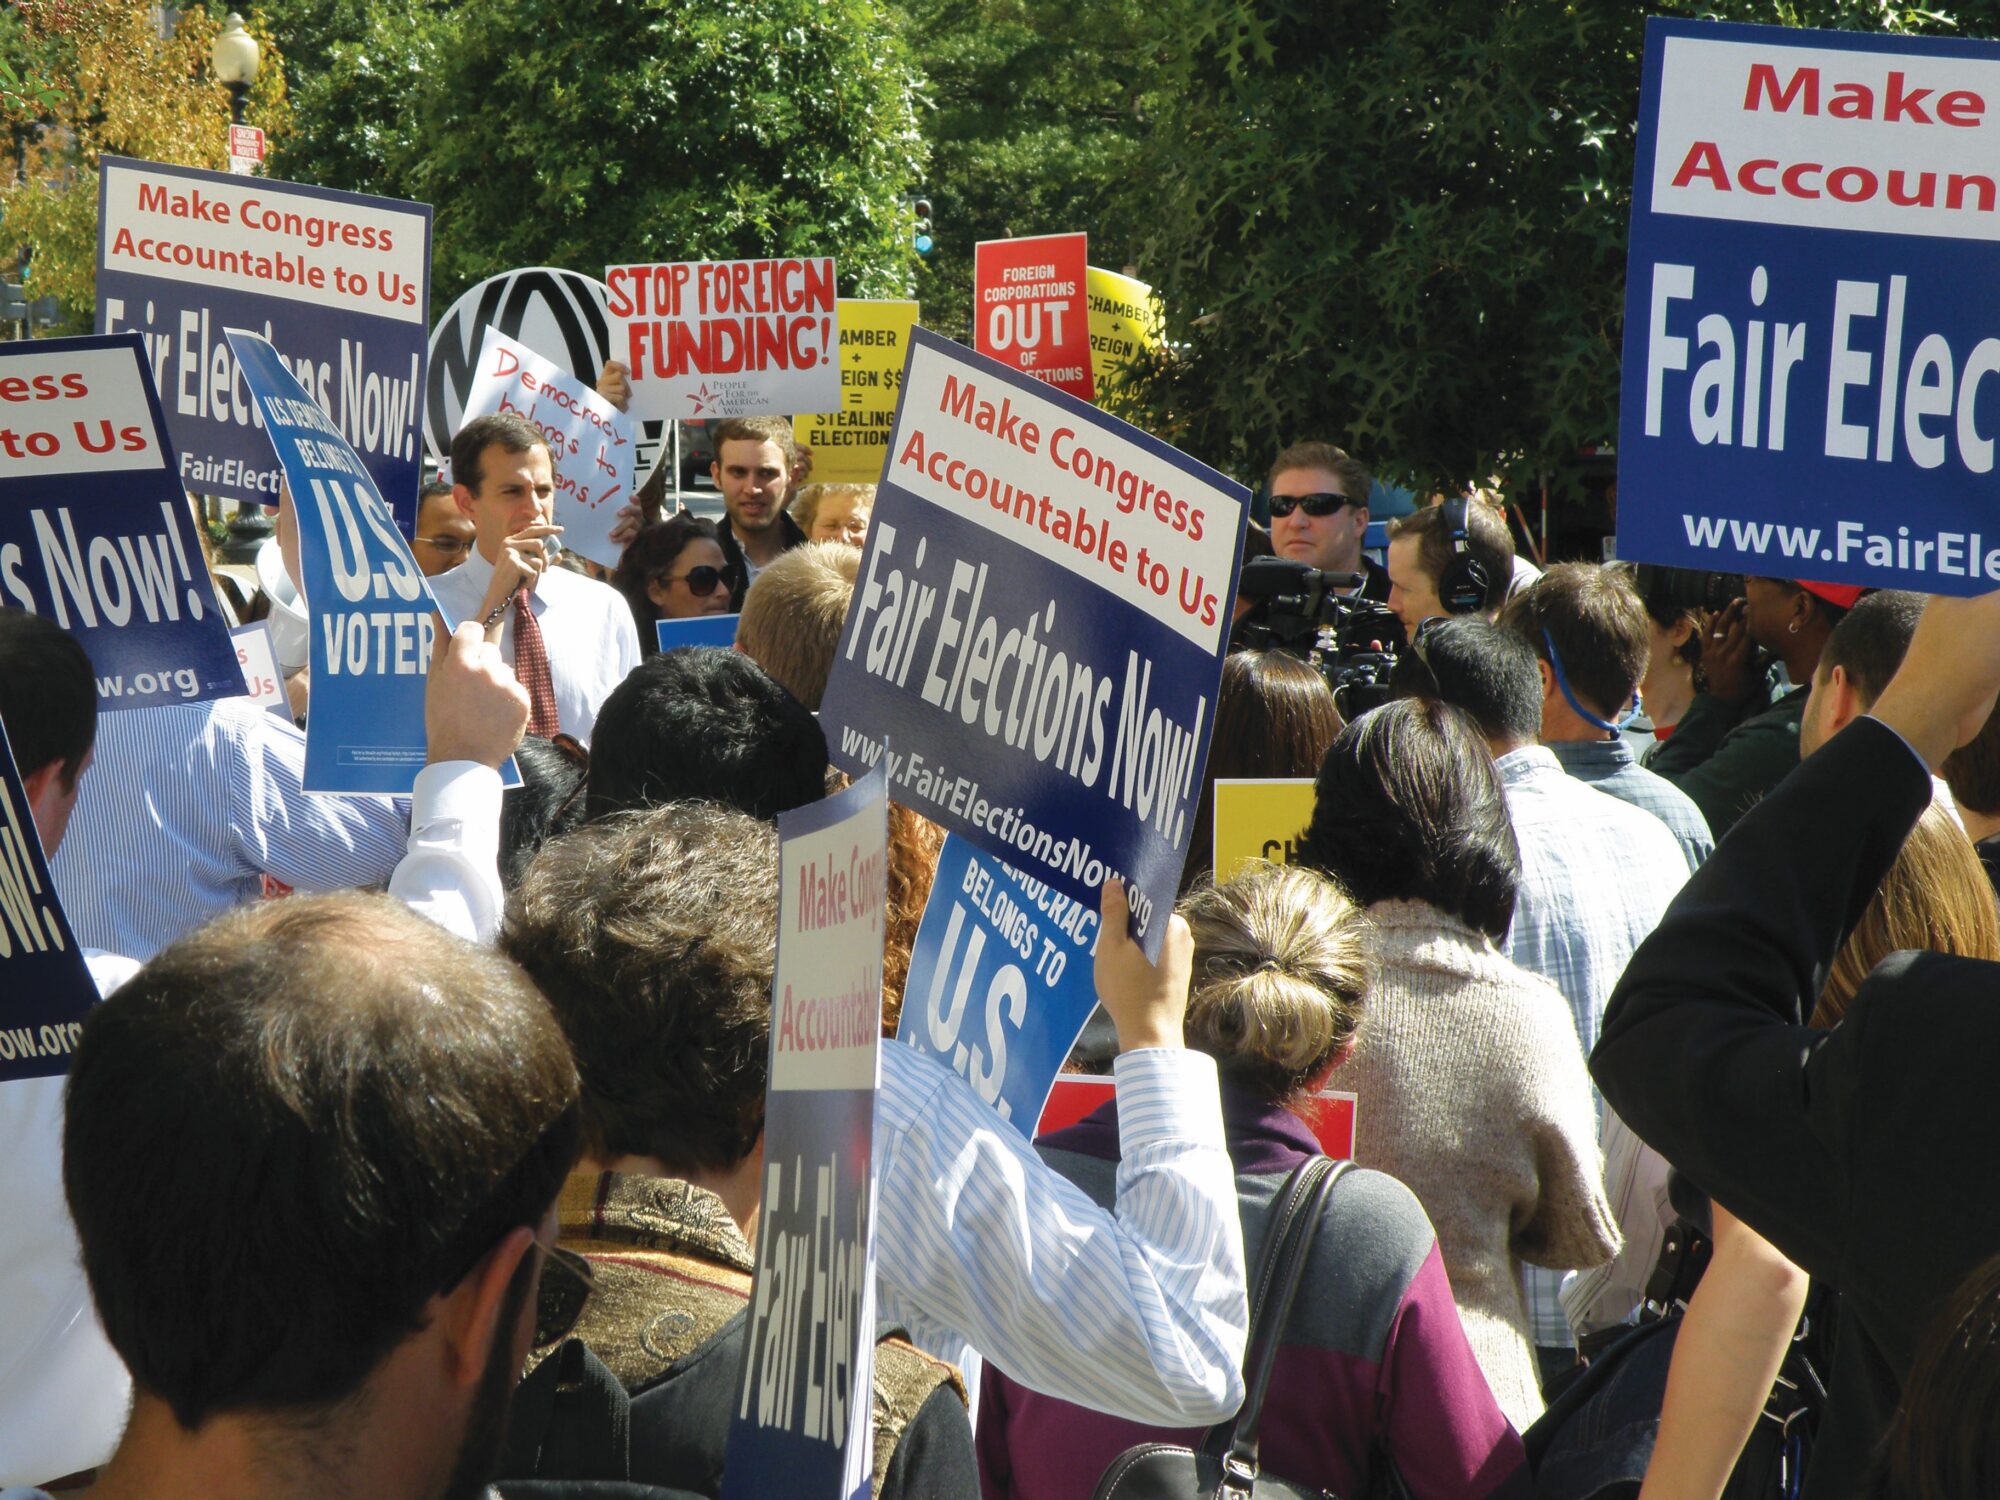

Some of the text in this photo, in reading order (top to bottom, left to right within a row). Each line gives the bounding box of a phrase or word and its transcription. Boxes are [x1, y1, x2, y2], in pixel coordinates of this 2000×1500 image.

[1742, 63, 1986, 128] Make
[1670, 140, 1996, 212] Accoun
[138, 183, 393, 252] Make Congress
[112, 228, 417, 306] Accountable to Us
[606, 258, 835, 318] STOP FOREIGN
[984, 281, 1076, 303] CORPORATIONS
[1003, 264, 1056, 283] FOREIGN
[628, 315, 832, 381] FUNDING!
[989, 301, 1069, 351] OUT
[1020, 351, 1037, 366] OF
[341, 338, 419, 463] Now!
[492, 347, 627, 446] Democracy
[718, 397, 769, 406] AMERICAN
[1644, 262, 2000, 474] Fair Elec
[0, 419, 148, 459] to Us
[723, 407, 745, 415] WAY
[596, 445, 617, 478] to
[938, 374, 1206, 542] Make Congress
[899, 430, 1219, 627] Accountable to Us
[30, 501, 203, 630] Now!
[845, 521, 1207, 851] Fair Elections Now!
[798, 852, 847, 933] Make
[961, 857, 1067, 988] BELONGS TO
[739, 1153, 810, 1432] Fair
